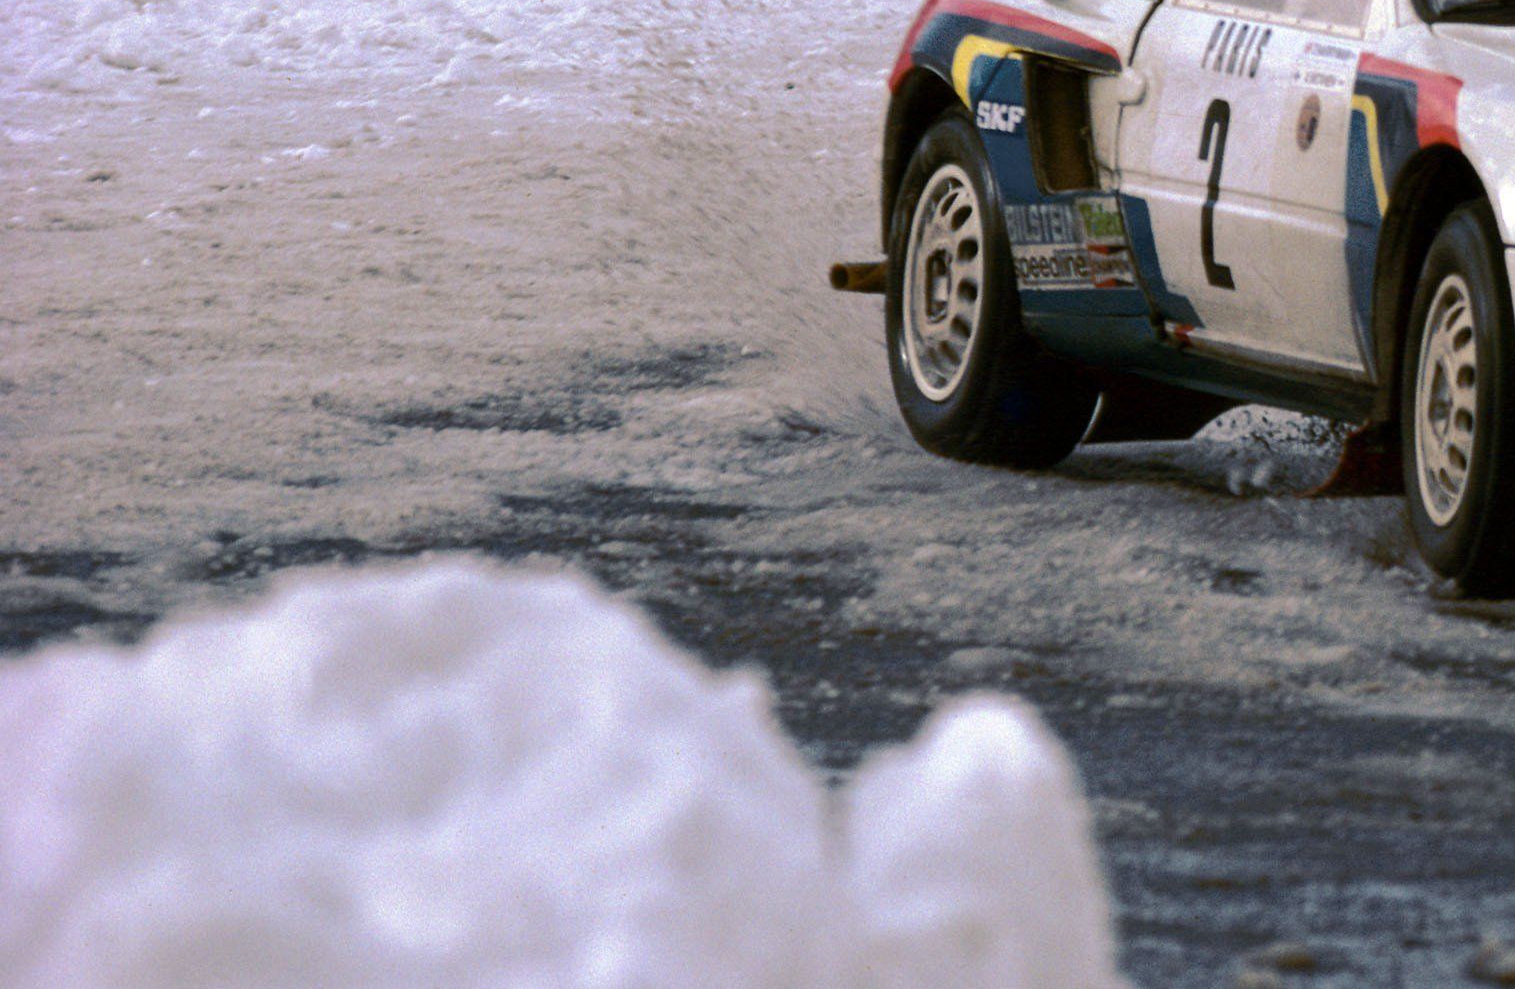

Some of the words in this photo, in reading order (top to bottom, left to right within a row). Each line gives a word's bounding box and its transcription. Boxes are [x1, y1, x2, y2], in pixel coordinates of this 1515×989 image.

[1201, 19, 1273, 78] PARIS
[976, 100, 1027, 133] SKF
[1198, 98, 1236, 291] 2
